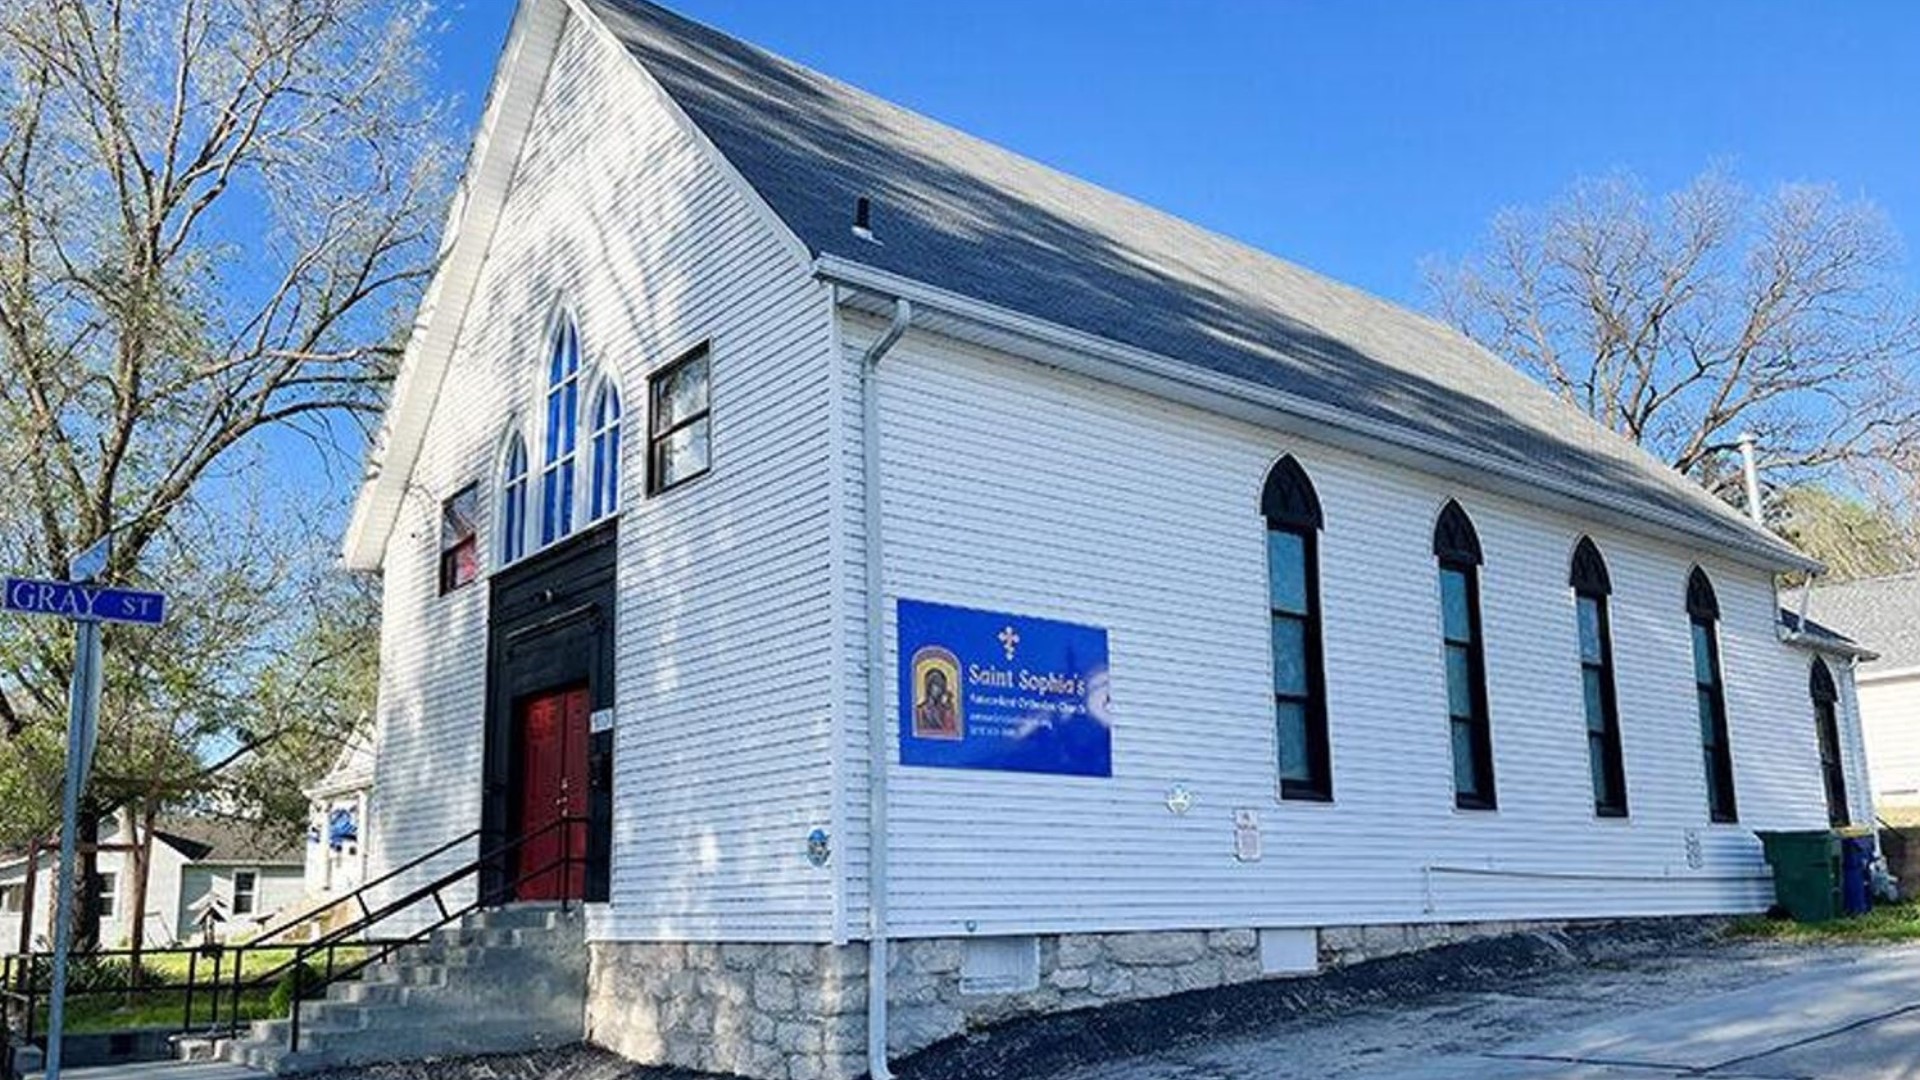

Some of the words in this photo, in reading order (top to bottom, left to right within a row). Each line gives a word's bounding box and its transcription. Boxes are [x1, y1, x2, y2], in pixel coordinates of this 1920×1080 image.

[13, 582, 101, 615] GRAY
[122, 596, 153, 615] ST
[968, 663, 1014, 688] Saint
[1018, 668, 1086, 696] Sophia's
